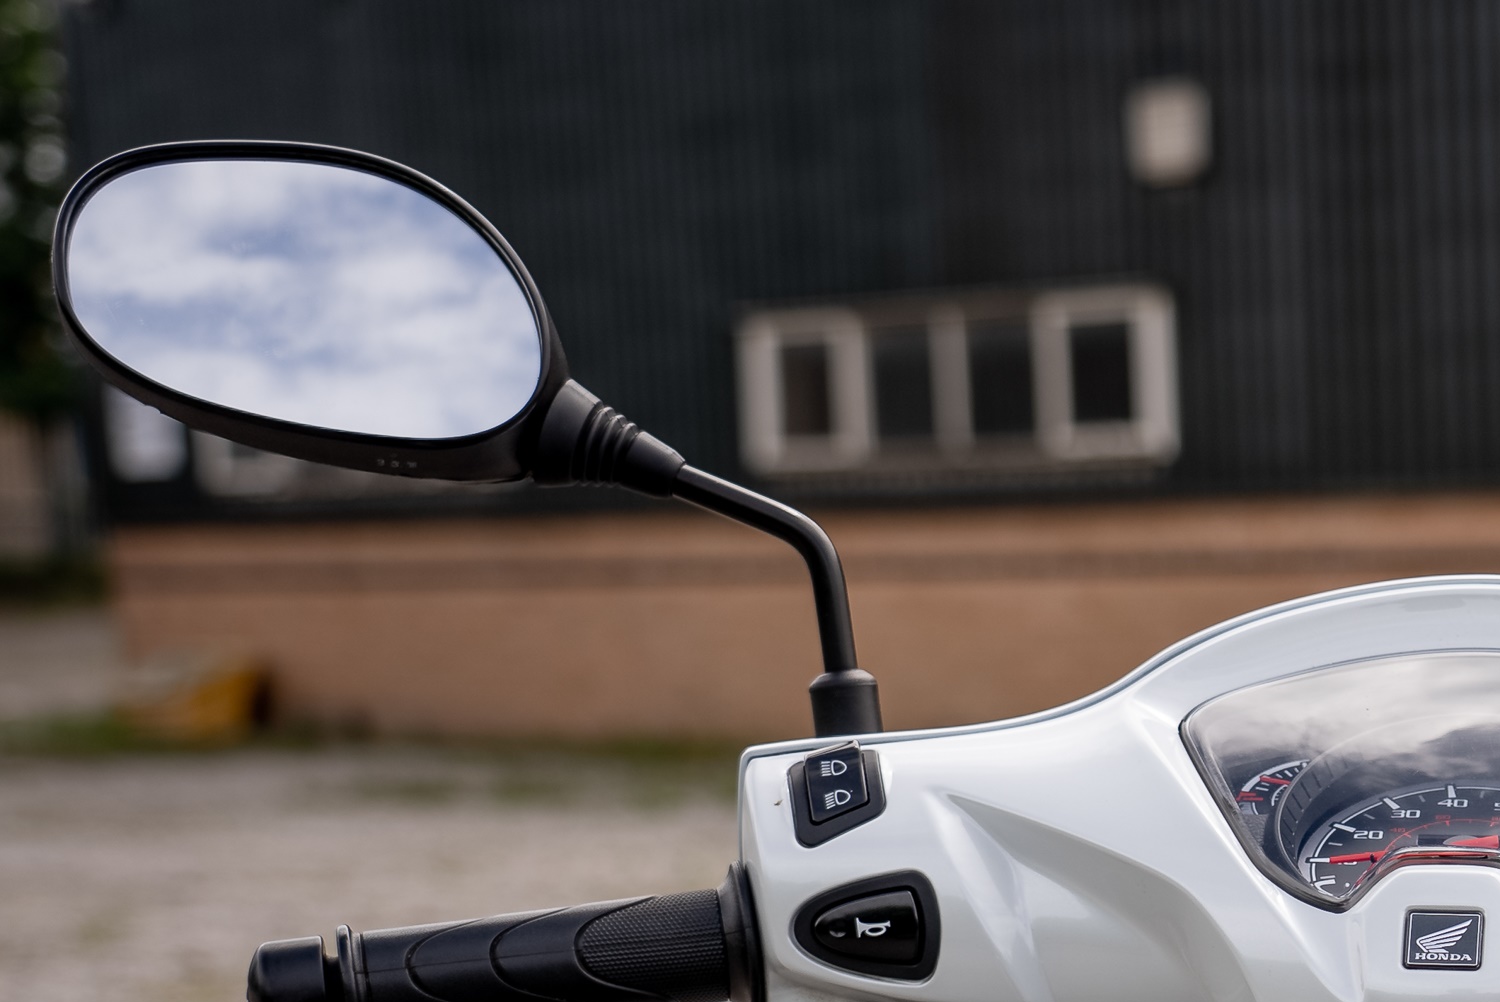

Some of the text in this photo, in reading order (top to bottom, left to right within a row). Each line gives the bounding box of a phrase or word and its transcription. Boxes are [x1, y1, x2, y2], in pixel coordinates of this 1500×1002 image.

[1437, 799, 1468, 808] 40
[1391, 809, 1421, 819] 30
[1353, 830, 1384, 840] 20
[1415, 952, 1472, 961] HONDA
